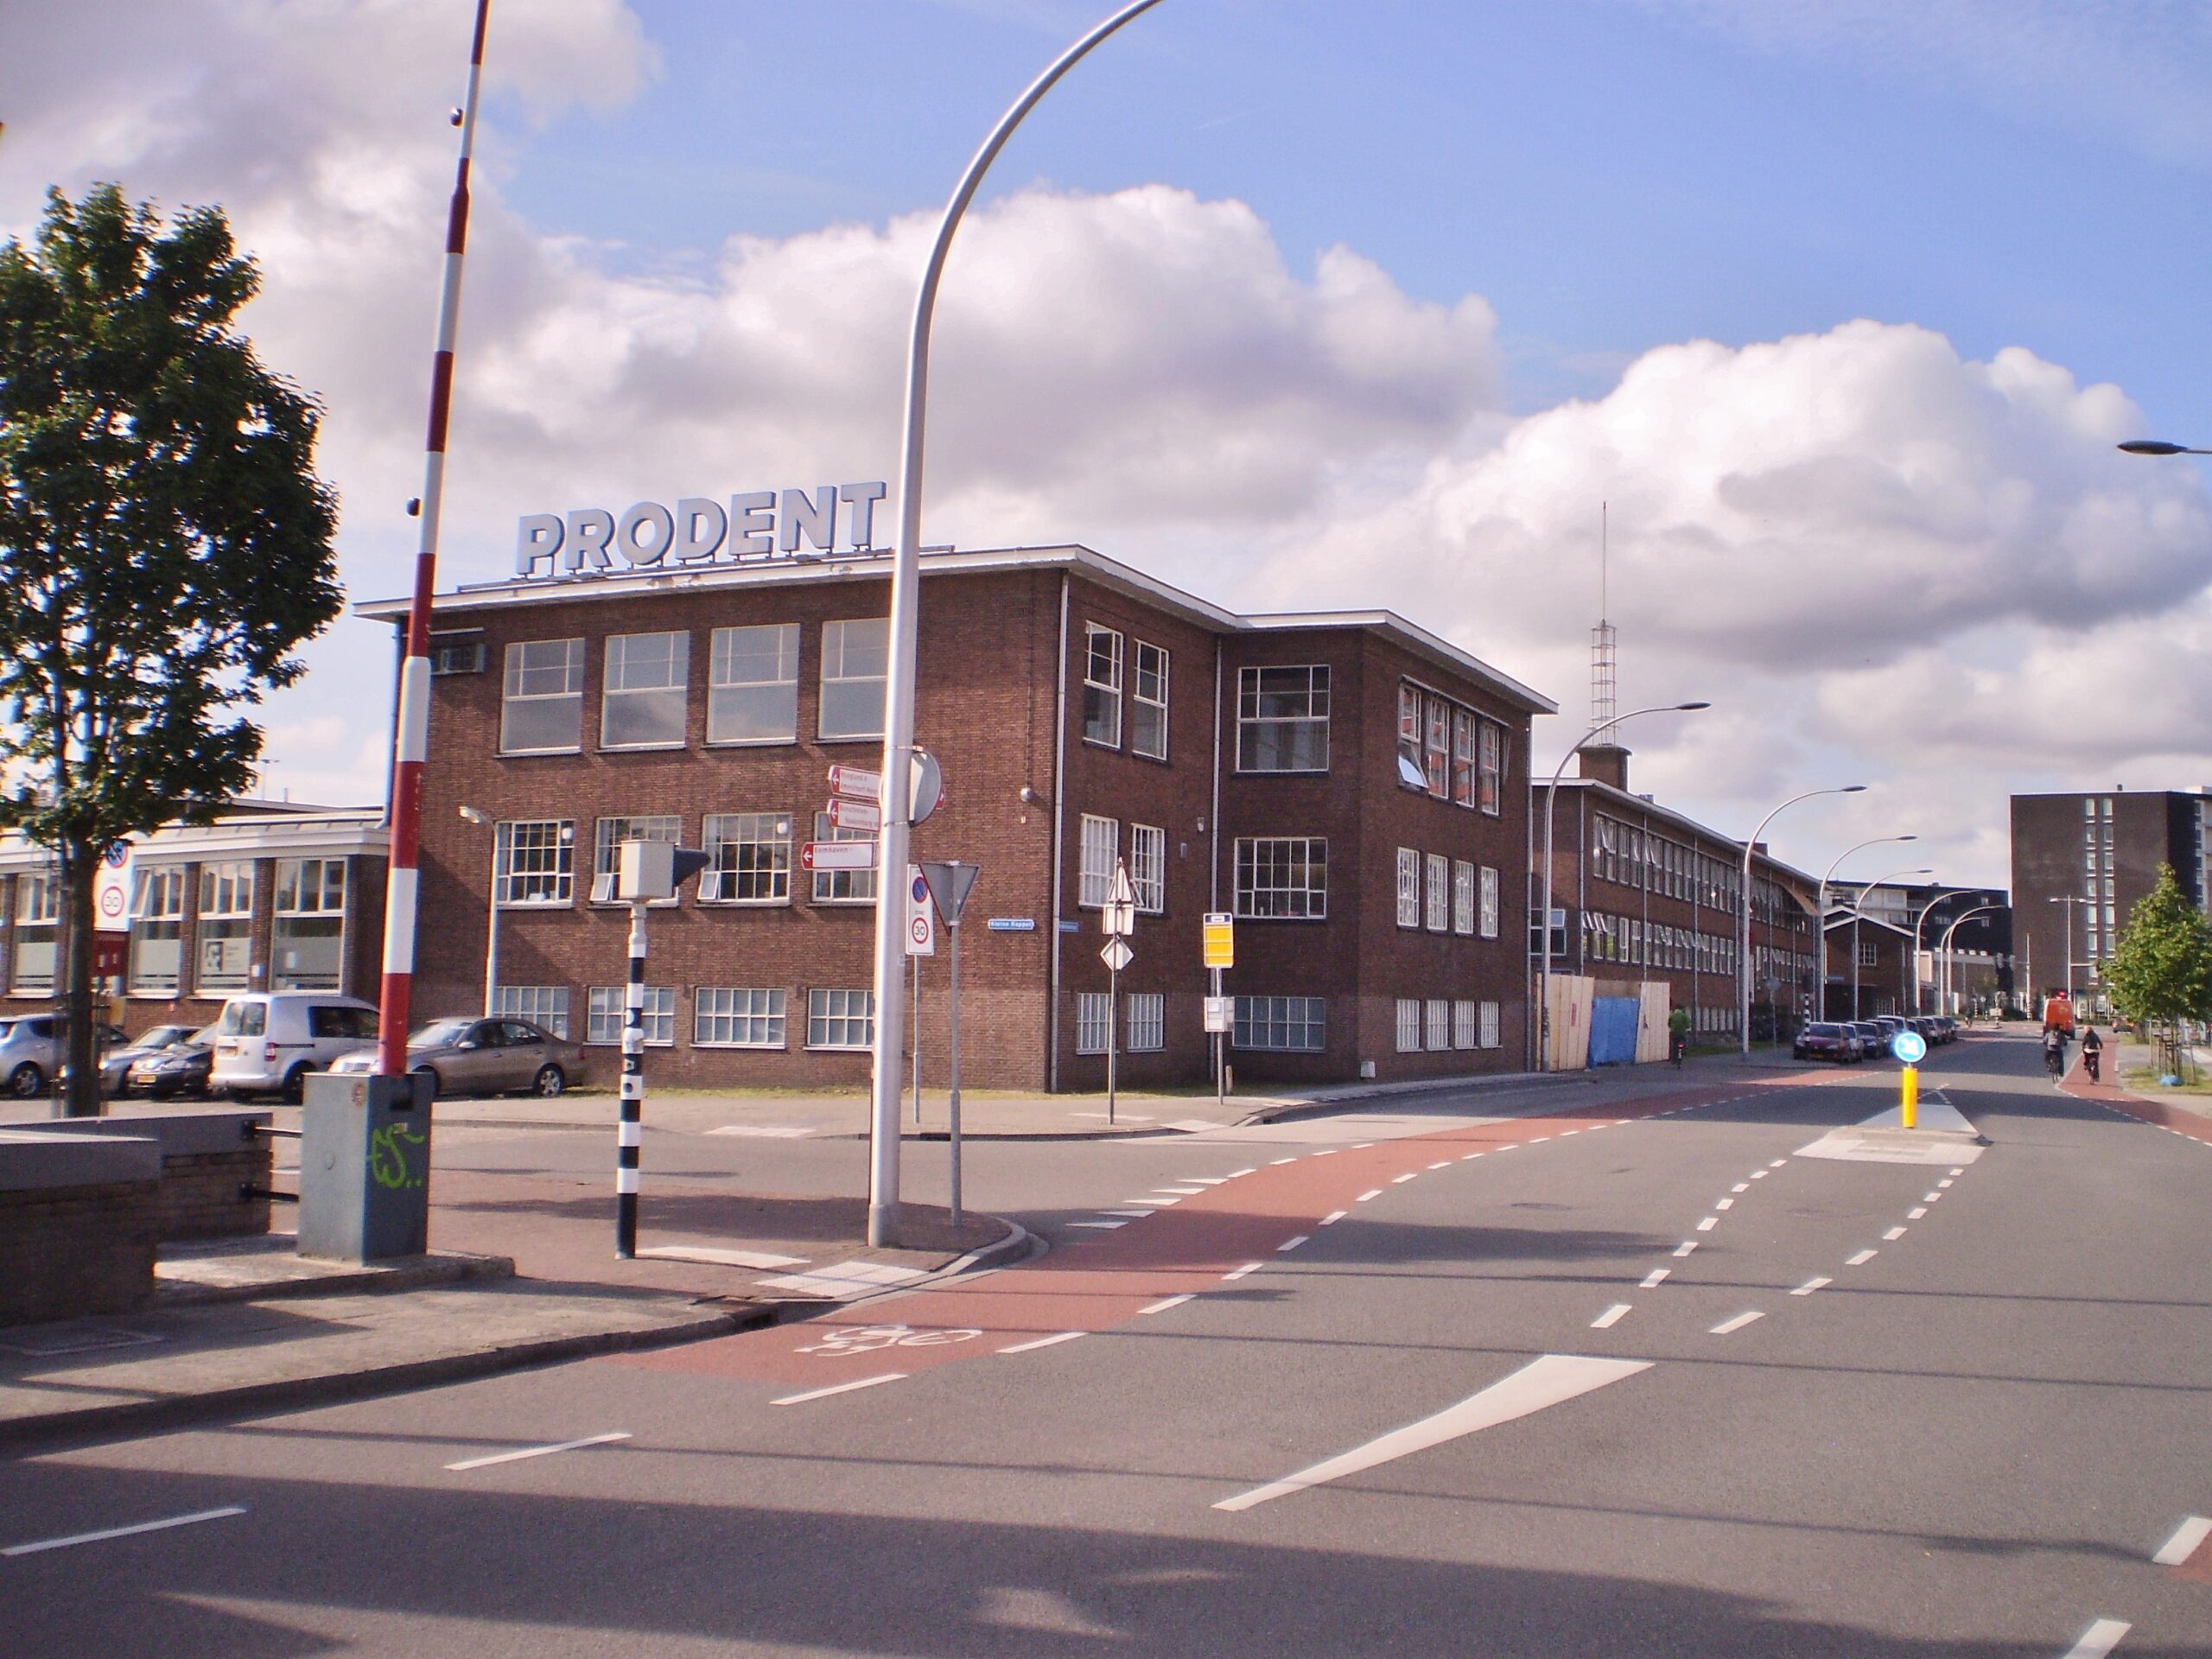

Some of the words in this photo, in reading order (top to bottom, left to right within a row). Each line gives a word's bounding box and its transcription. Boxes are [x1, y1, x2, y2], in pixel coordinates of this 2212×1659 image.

[517, 480, 887, 575] PRODENT
[105, 895, 120, 907] 30
[914, 925, 925, 936] 30
